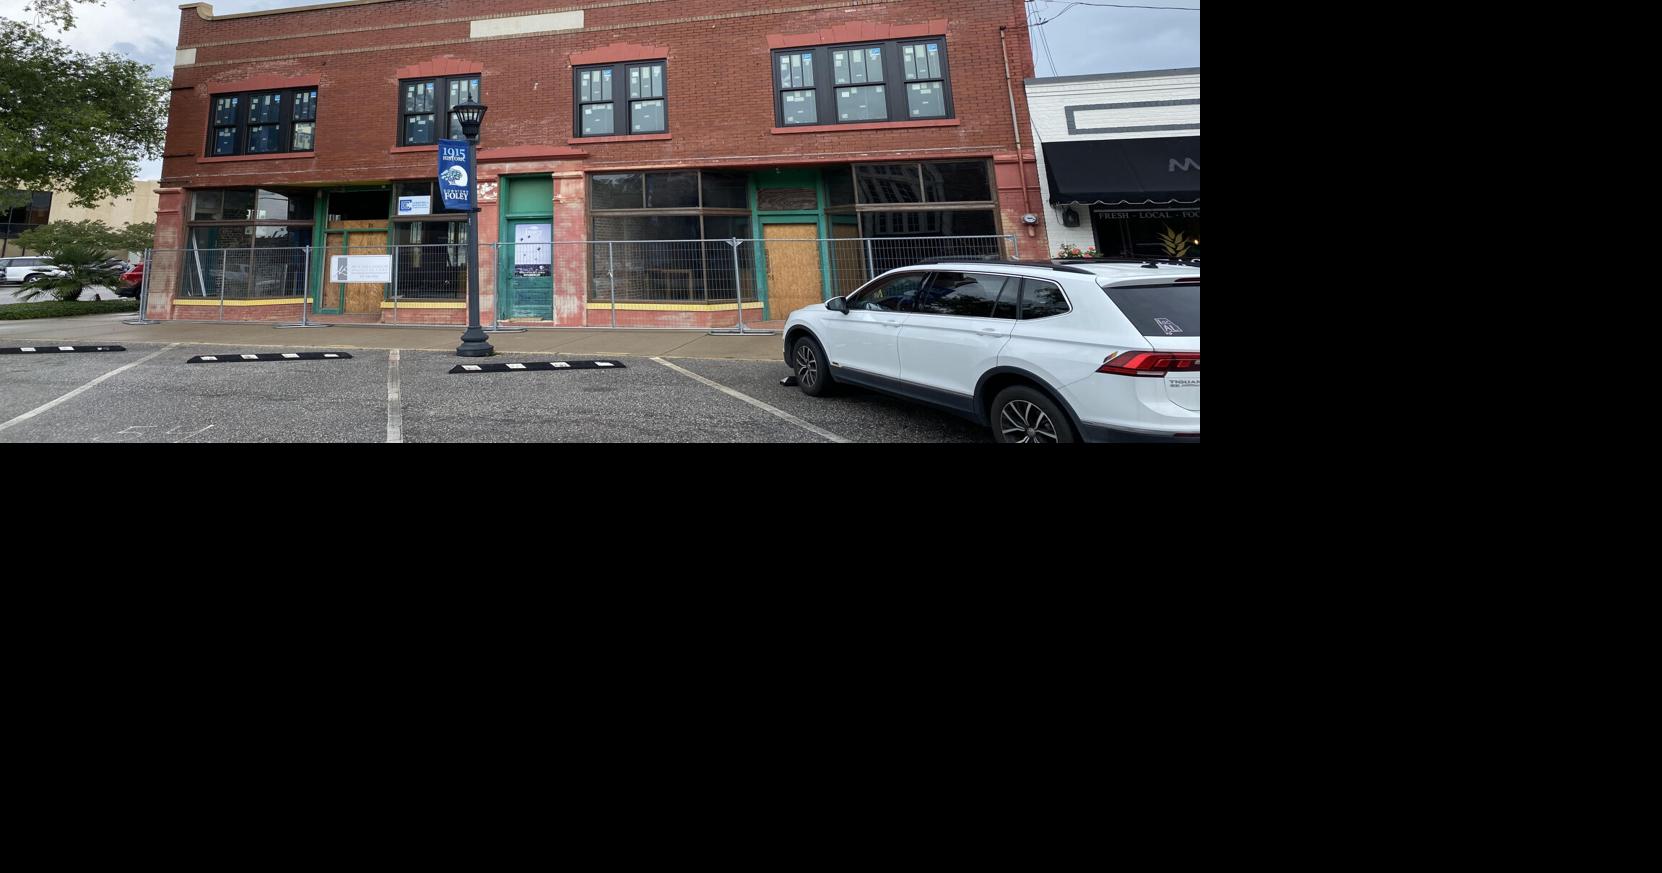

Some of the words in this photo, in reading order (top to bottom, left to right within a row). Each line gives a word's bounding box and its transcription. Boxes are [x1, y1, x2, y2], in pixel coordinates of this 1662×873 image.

[443, 147, 466, 160] 1915
[444, 192, 469, 200] FOLEY
[1139, 211, 1172, 219] LOCAL
